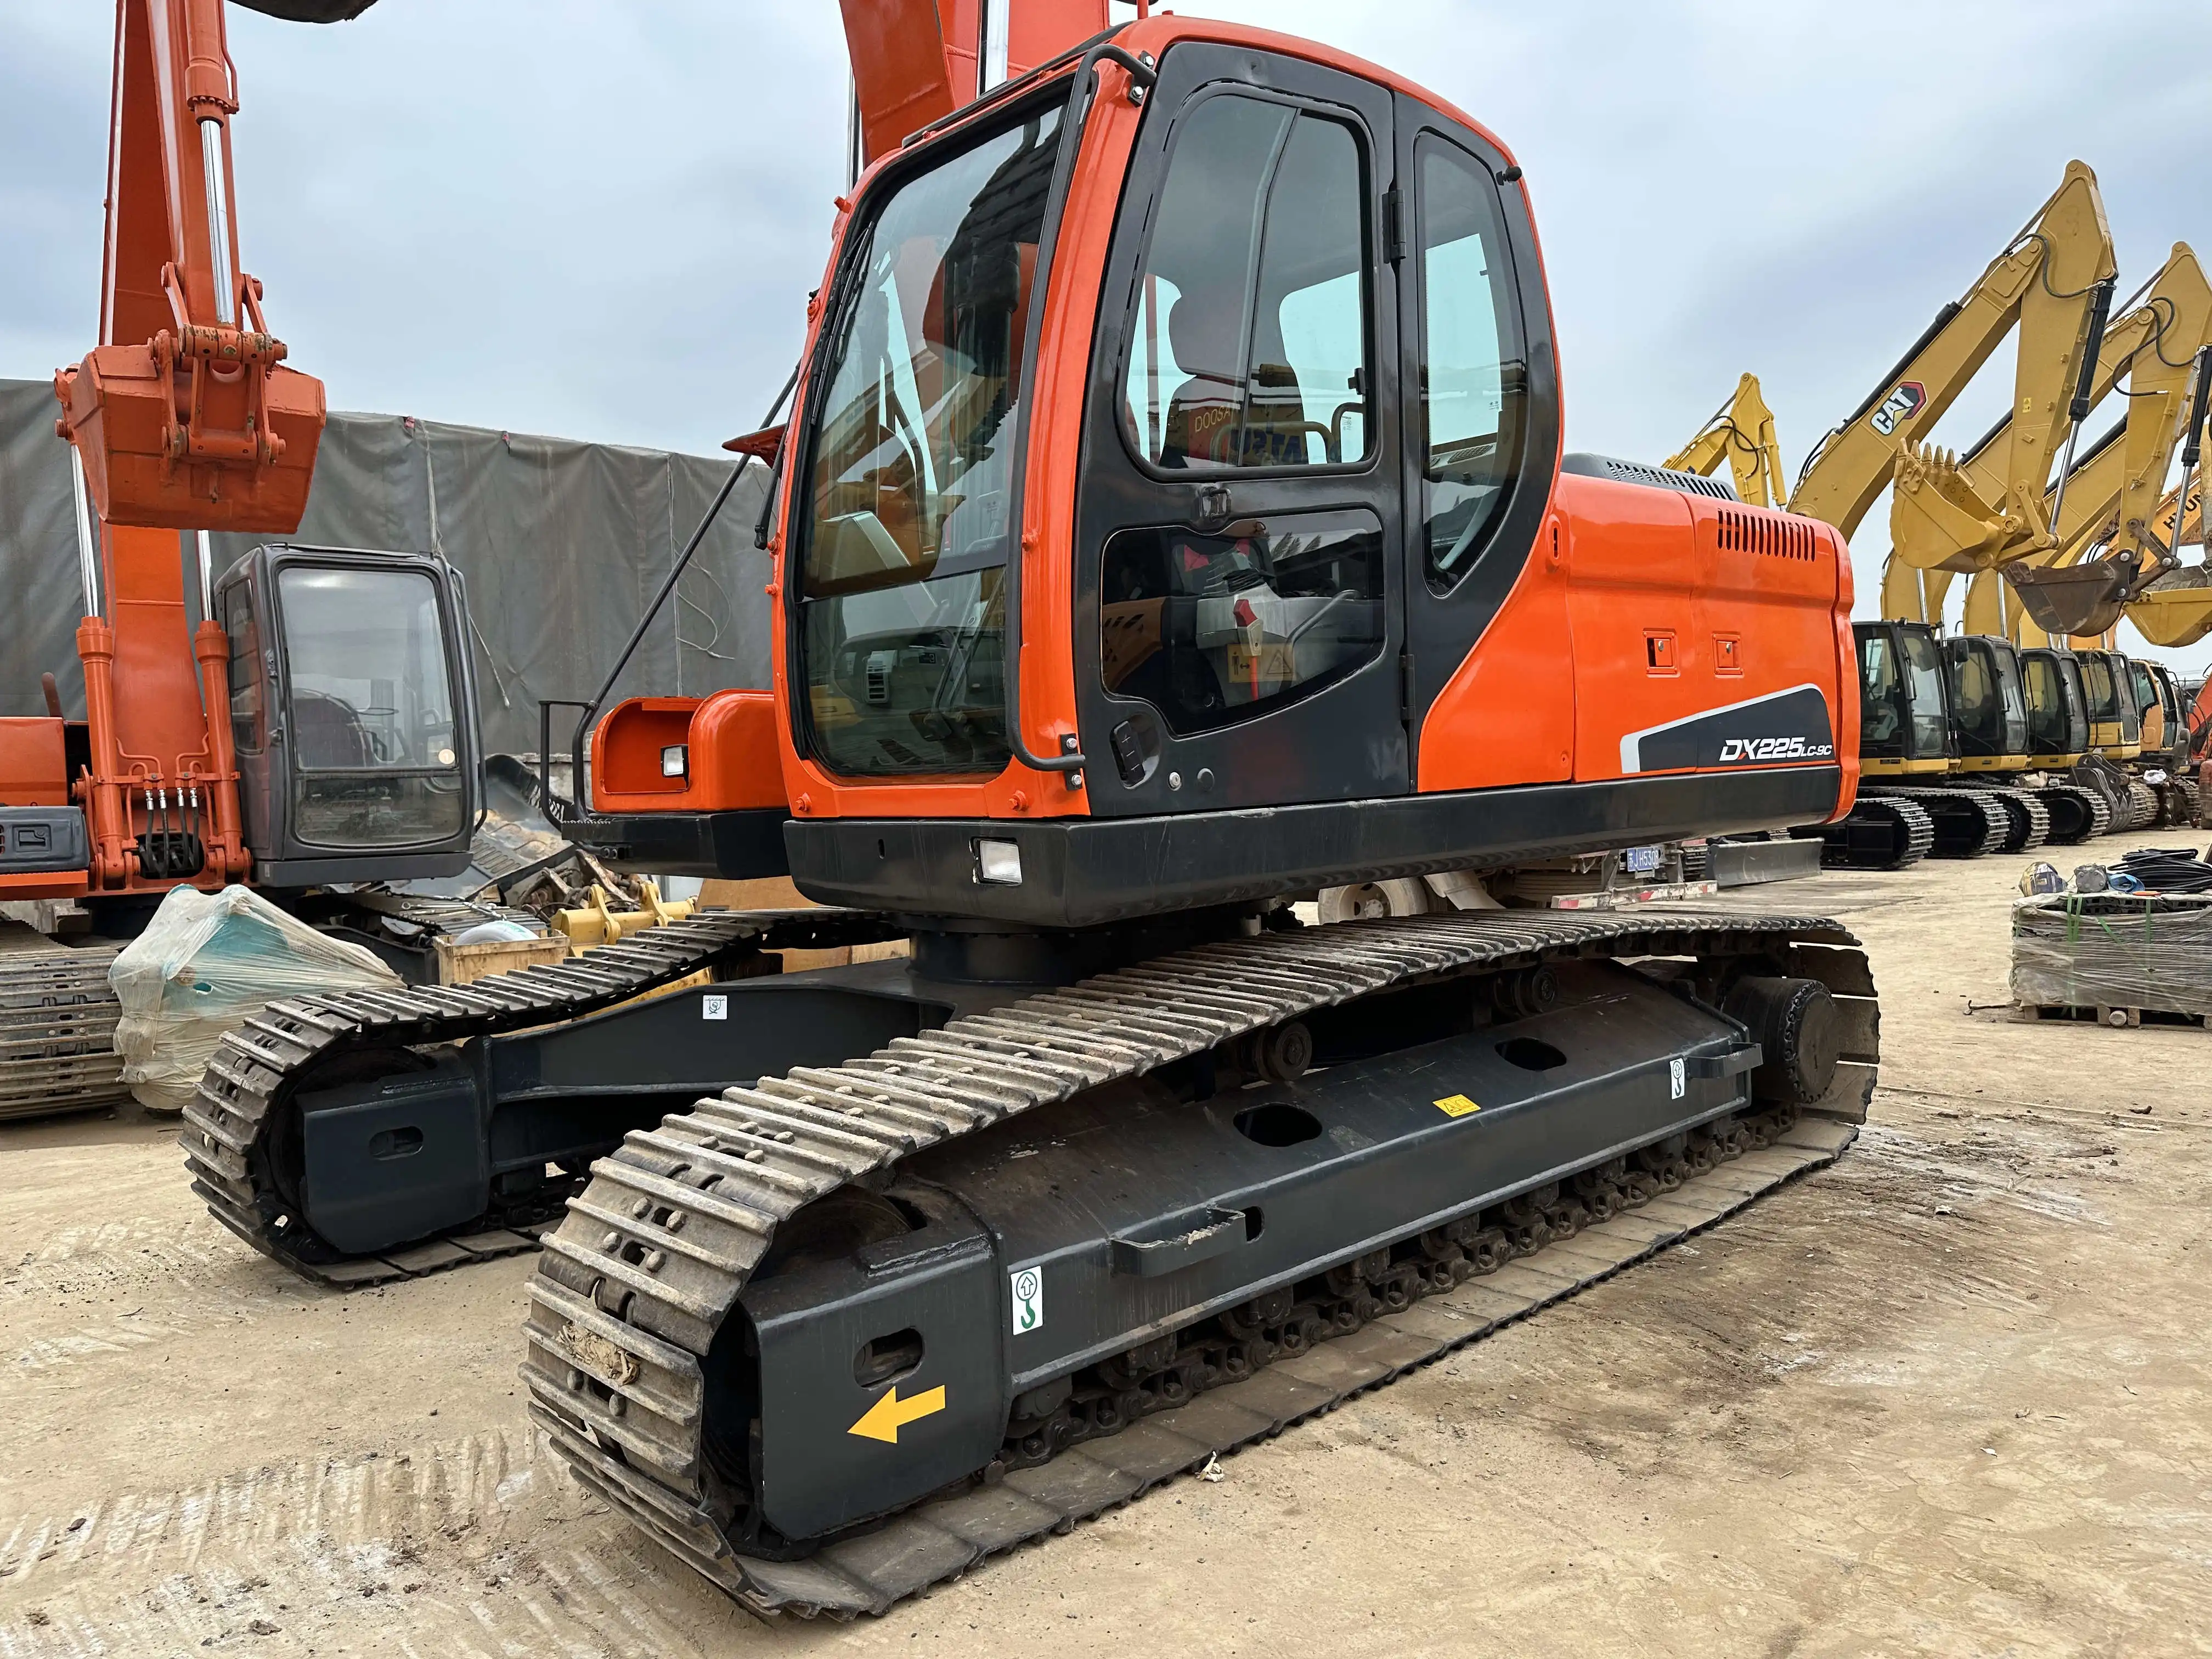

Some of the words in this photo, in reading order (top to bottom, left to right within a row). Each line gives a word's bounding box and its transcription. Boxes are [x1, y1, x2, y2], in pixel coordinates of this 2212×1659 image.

[1195, 405, 1232, 433] DOOSA
[1871, 387, 1914, 435] CAT
[1719, 737, 1832, 761] DX225LC-9C
